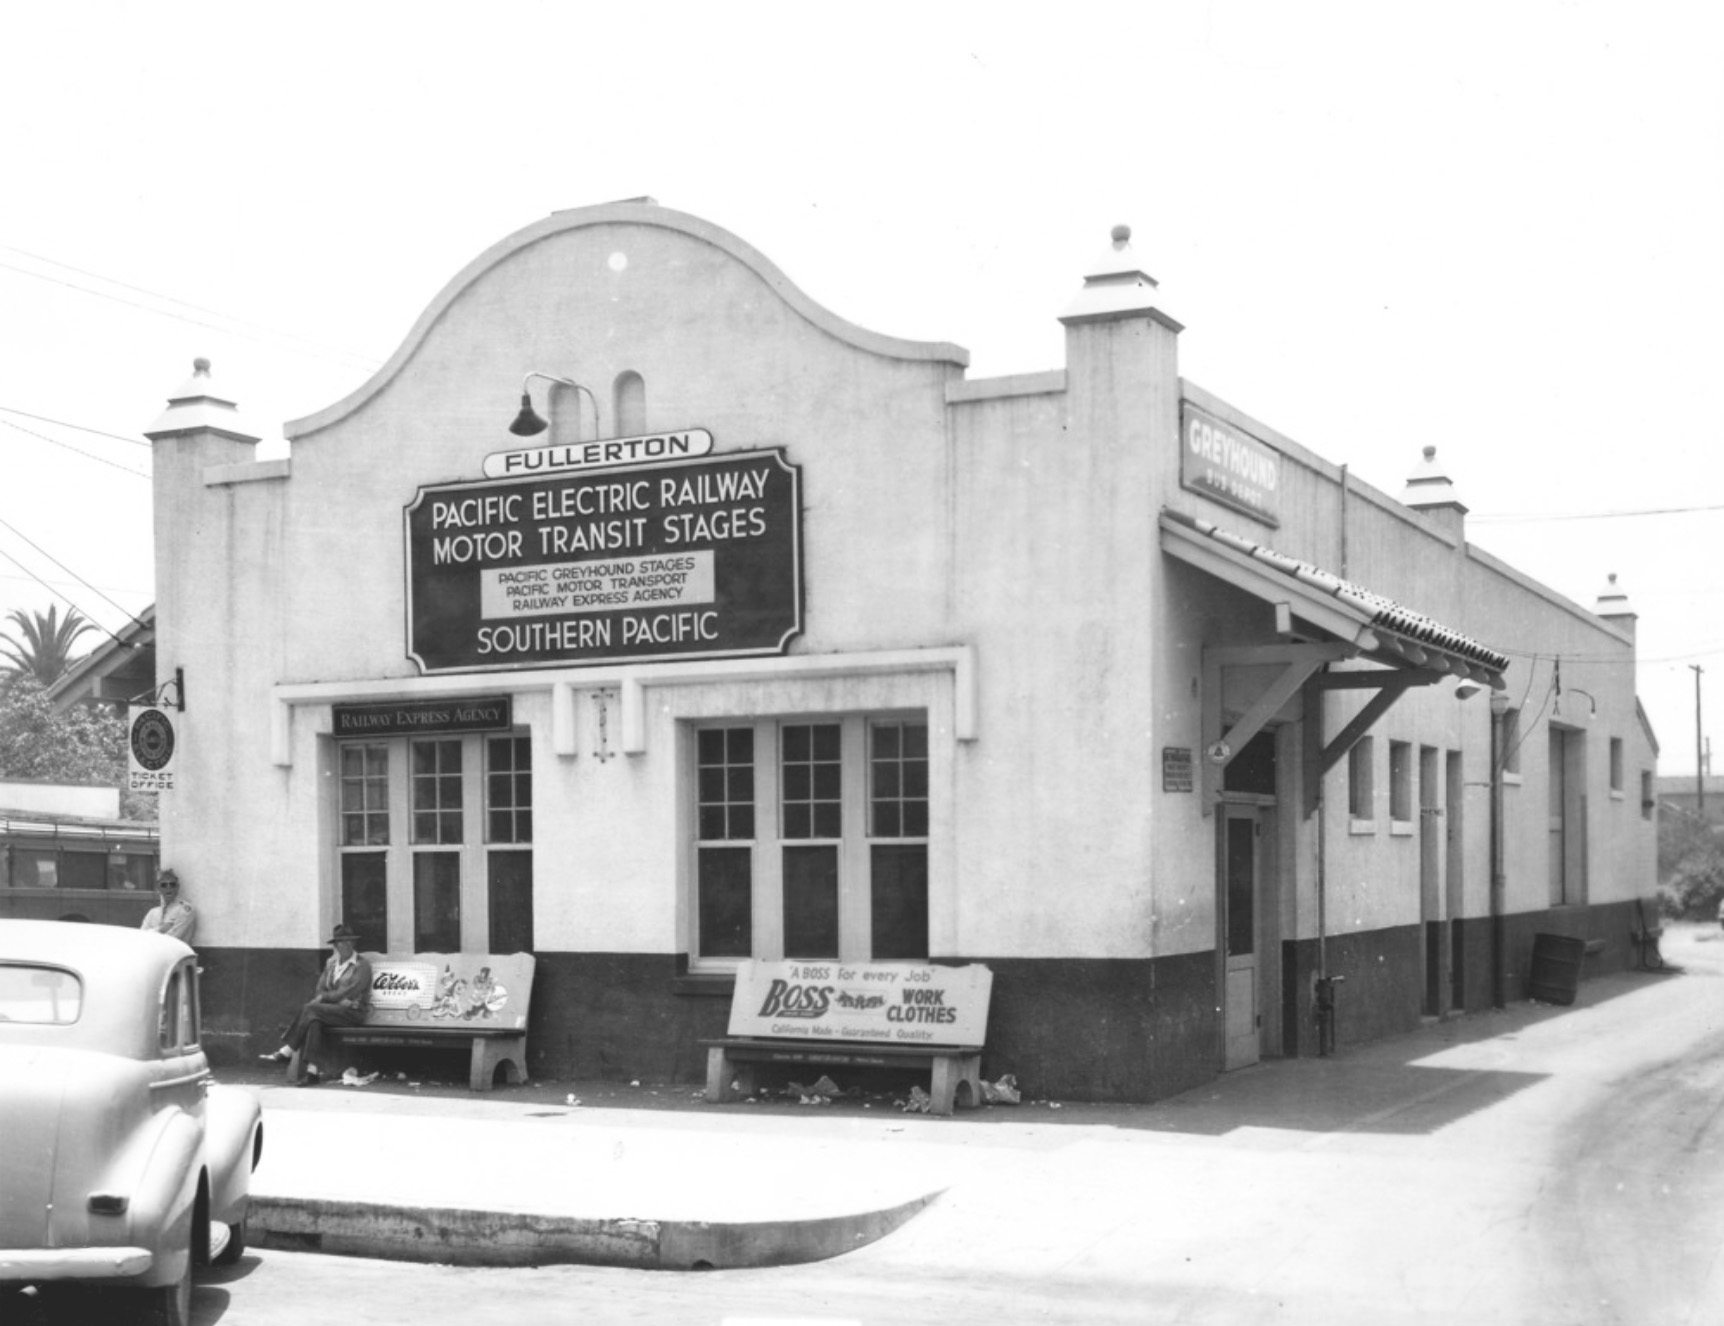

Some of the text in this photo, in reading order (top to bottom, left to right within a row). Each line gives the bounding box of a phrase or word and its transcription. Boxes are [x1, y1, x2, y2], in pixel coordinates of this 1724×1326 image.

[504, 434, 690, 473] FULLERTON
[1189, 418, 1277, 491] GREYHOUND
[432, 469, 770, 530] PACIFIC ELECTRIC RAILWAY
[433, 507, 766, 565] MOTOR TRANSIT STAGES
[498, 557, 695, 585] PACIFIC GREYHOUND STAGES
[506, 572, 687, 598] PACIFIC MOTOR TRANSPORT
[512, 586, 684, 612] RAILWAY EXPRESS AGENCY
[477, 611, 719, 655] SOUTHERN PACIFIC
[132, 772, 173, 780] TICKET
[132, 781, 173, 789] OFFICE
[802, 967, 831, 980] BOSS
[863, 971, 899, 985] every
[902, 988, 945, 1005] WORK
[887, 1005, 957, 1024] CLOTHES
[772, 1023, 809, 1036] California
[811, 1025, 833, 1036] Made
[841, 1027, 891, 1038] Guaranteed
